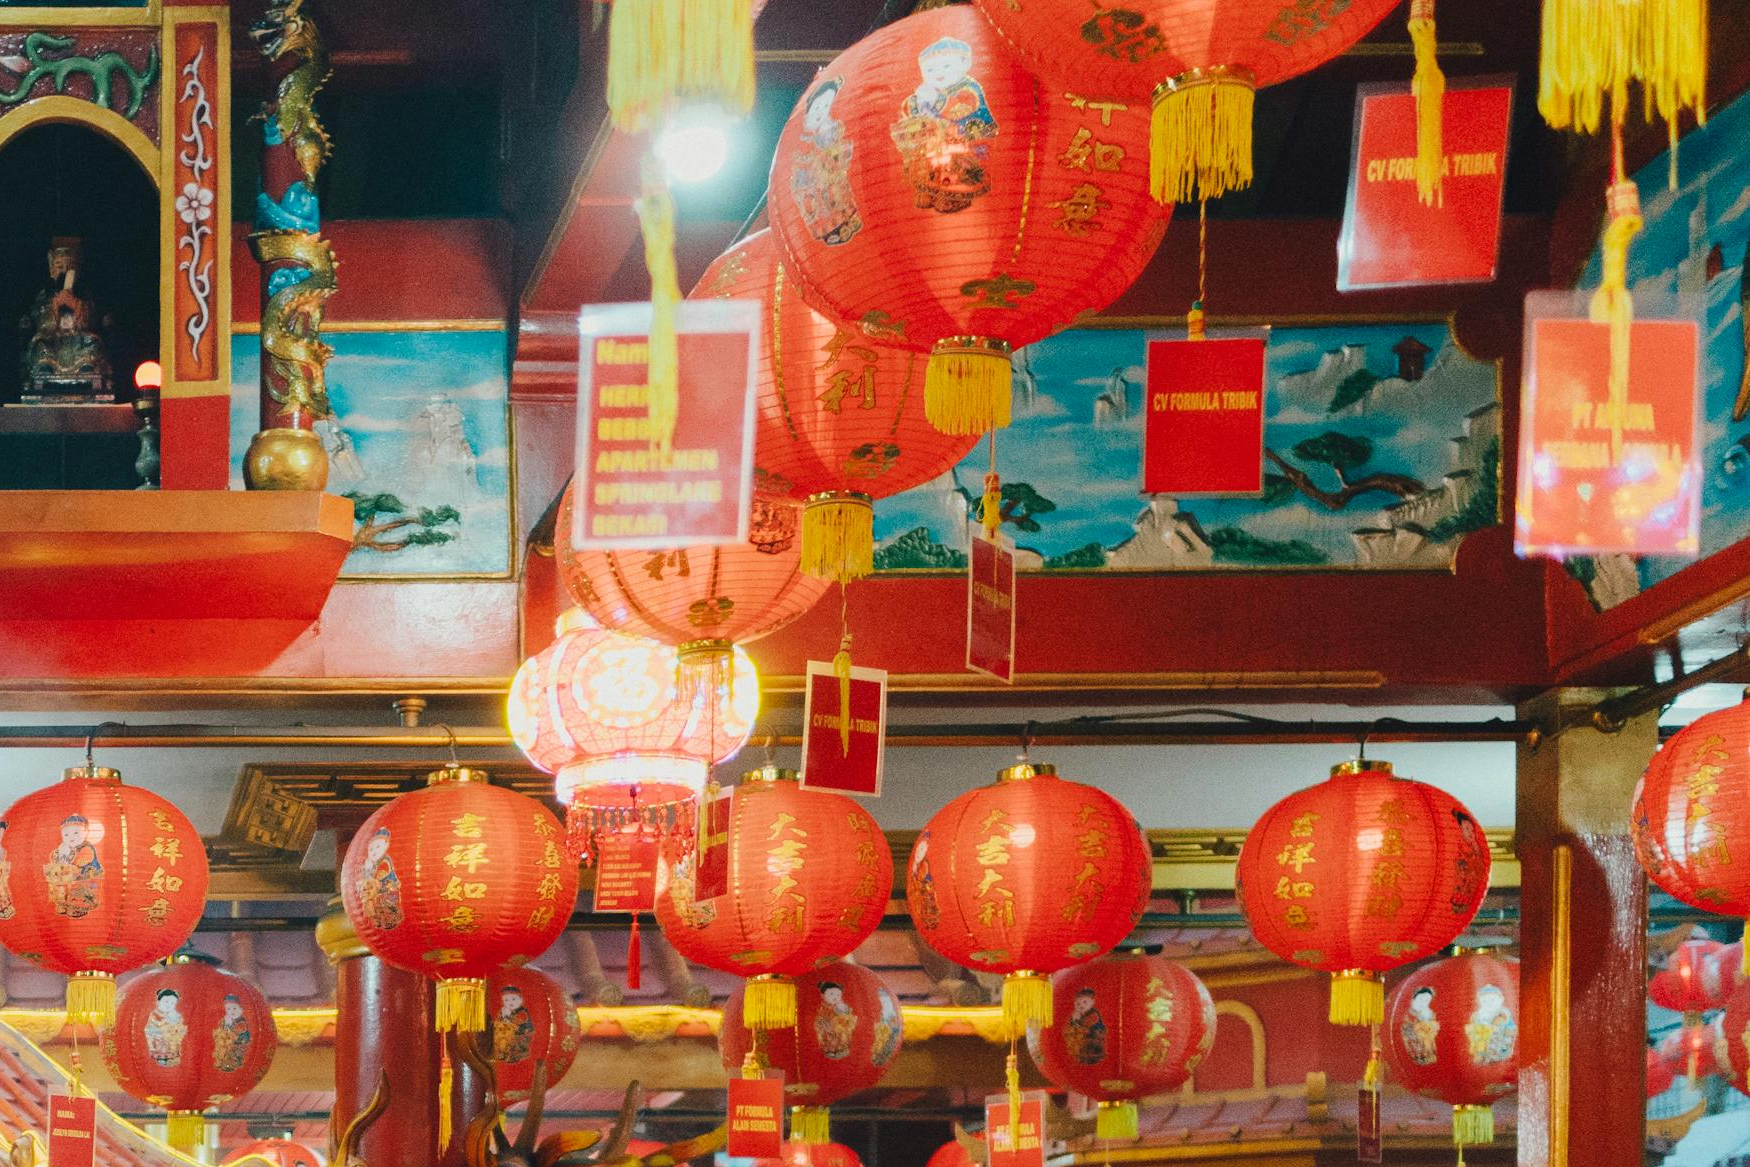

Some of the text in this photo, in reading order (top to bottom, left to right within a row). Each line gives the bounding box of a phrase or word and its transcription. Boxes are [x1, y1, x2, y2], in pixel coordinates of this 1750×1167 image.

[1367, 152, 1497, 182] CV FORA TRIBIK
[1154, 391, 1258, 411] CV FORMULA TRIBIK
[824, 714, 854, 731] FORA
[138, 808, 184, 927] 吉祥如意
[437, 812, 491, 933] 吉祥如意
[762, 812, 808, 935] 大吉大利
[973, 808, 1017, 930] 大吉大利
[1272, 811, 1322, 931] 吉祥如意
[736, 1104, 744, 1117] PT
